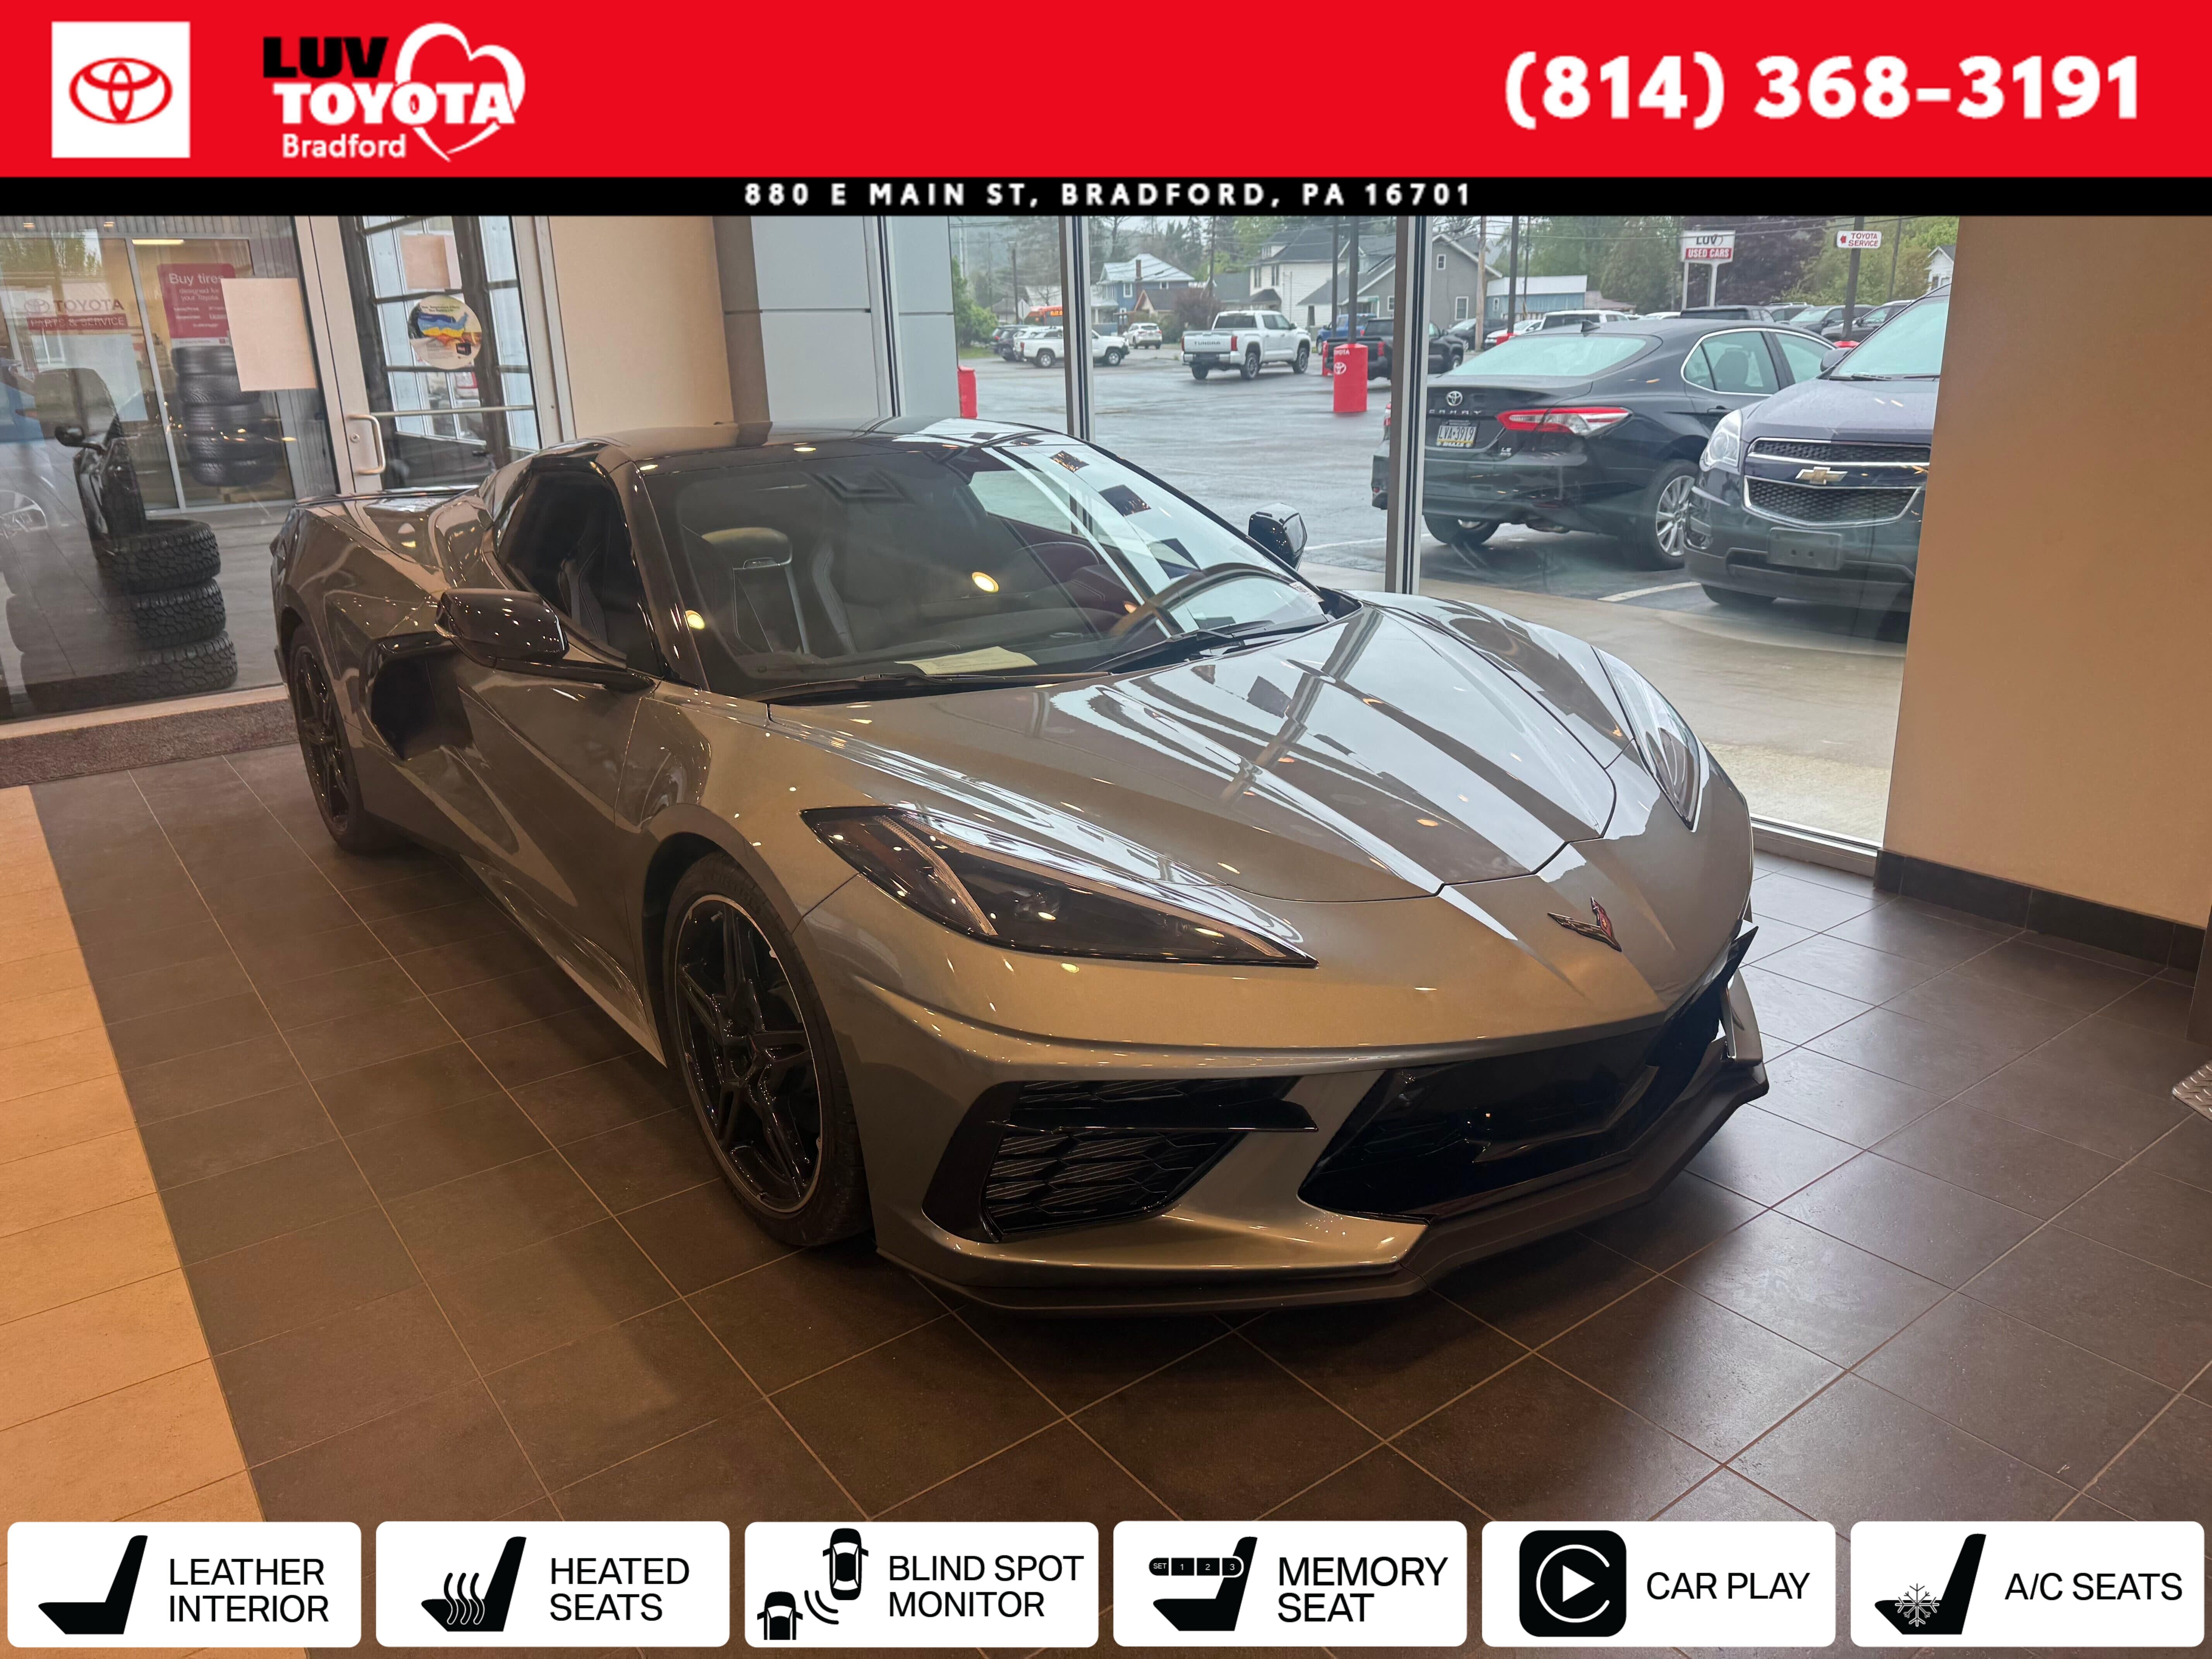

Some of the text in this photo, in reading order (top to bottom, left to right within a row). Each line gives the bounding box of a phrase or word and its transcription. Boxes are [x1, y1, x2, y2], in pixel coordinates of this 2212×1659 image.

[1696, 235, 1717, 244] LUV
[1688, 249, 1729, 258] USED CARS
[169, 273, 194, 286] Buy
[54, 299, 124, 312] TOYOTA
[69, 318, 77, 326] &
[81, 316, 125, 327] SERVICE
